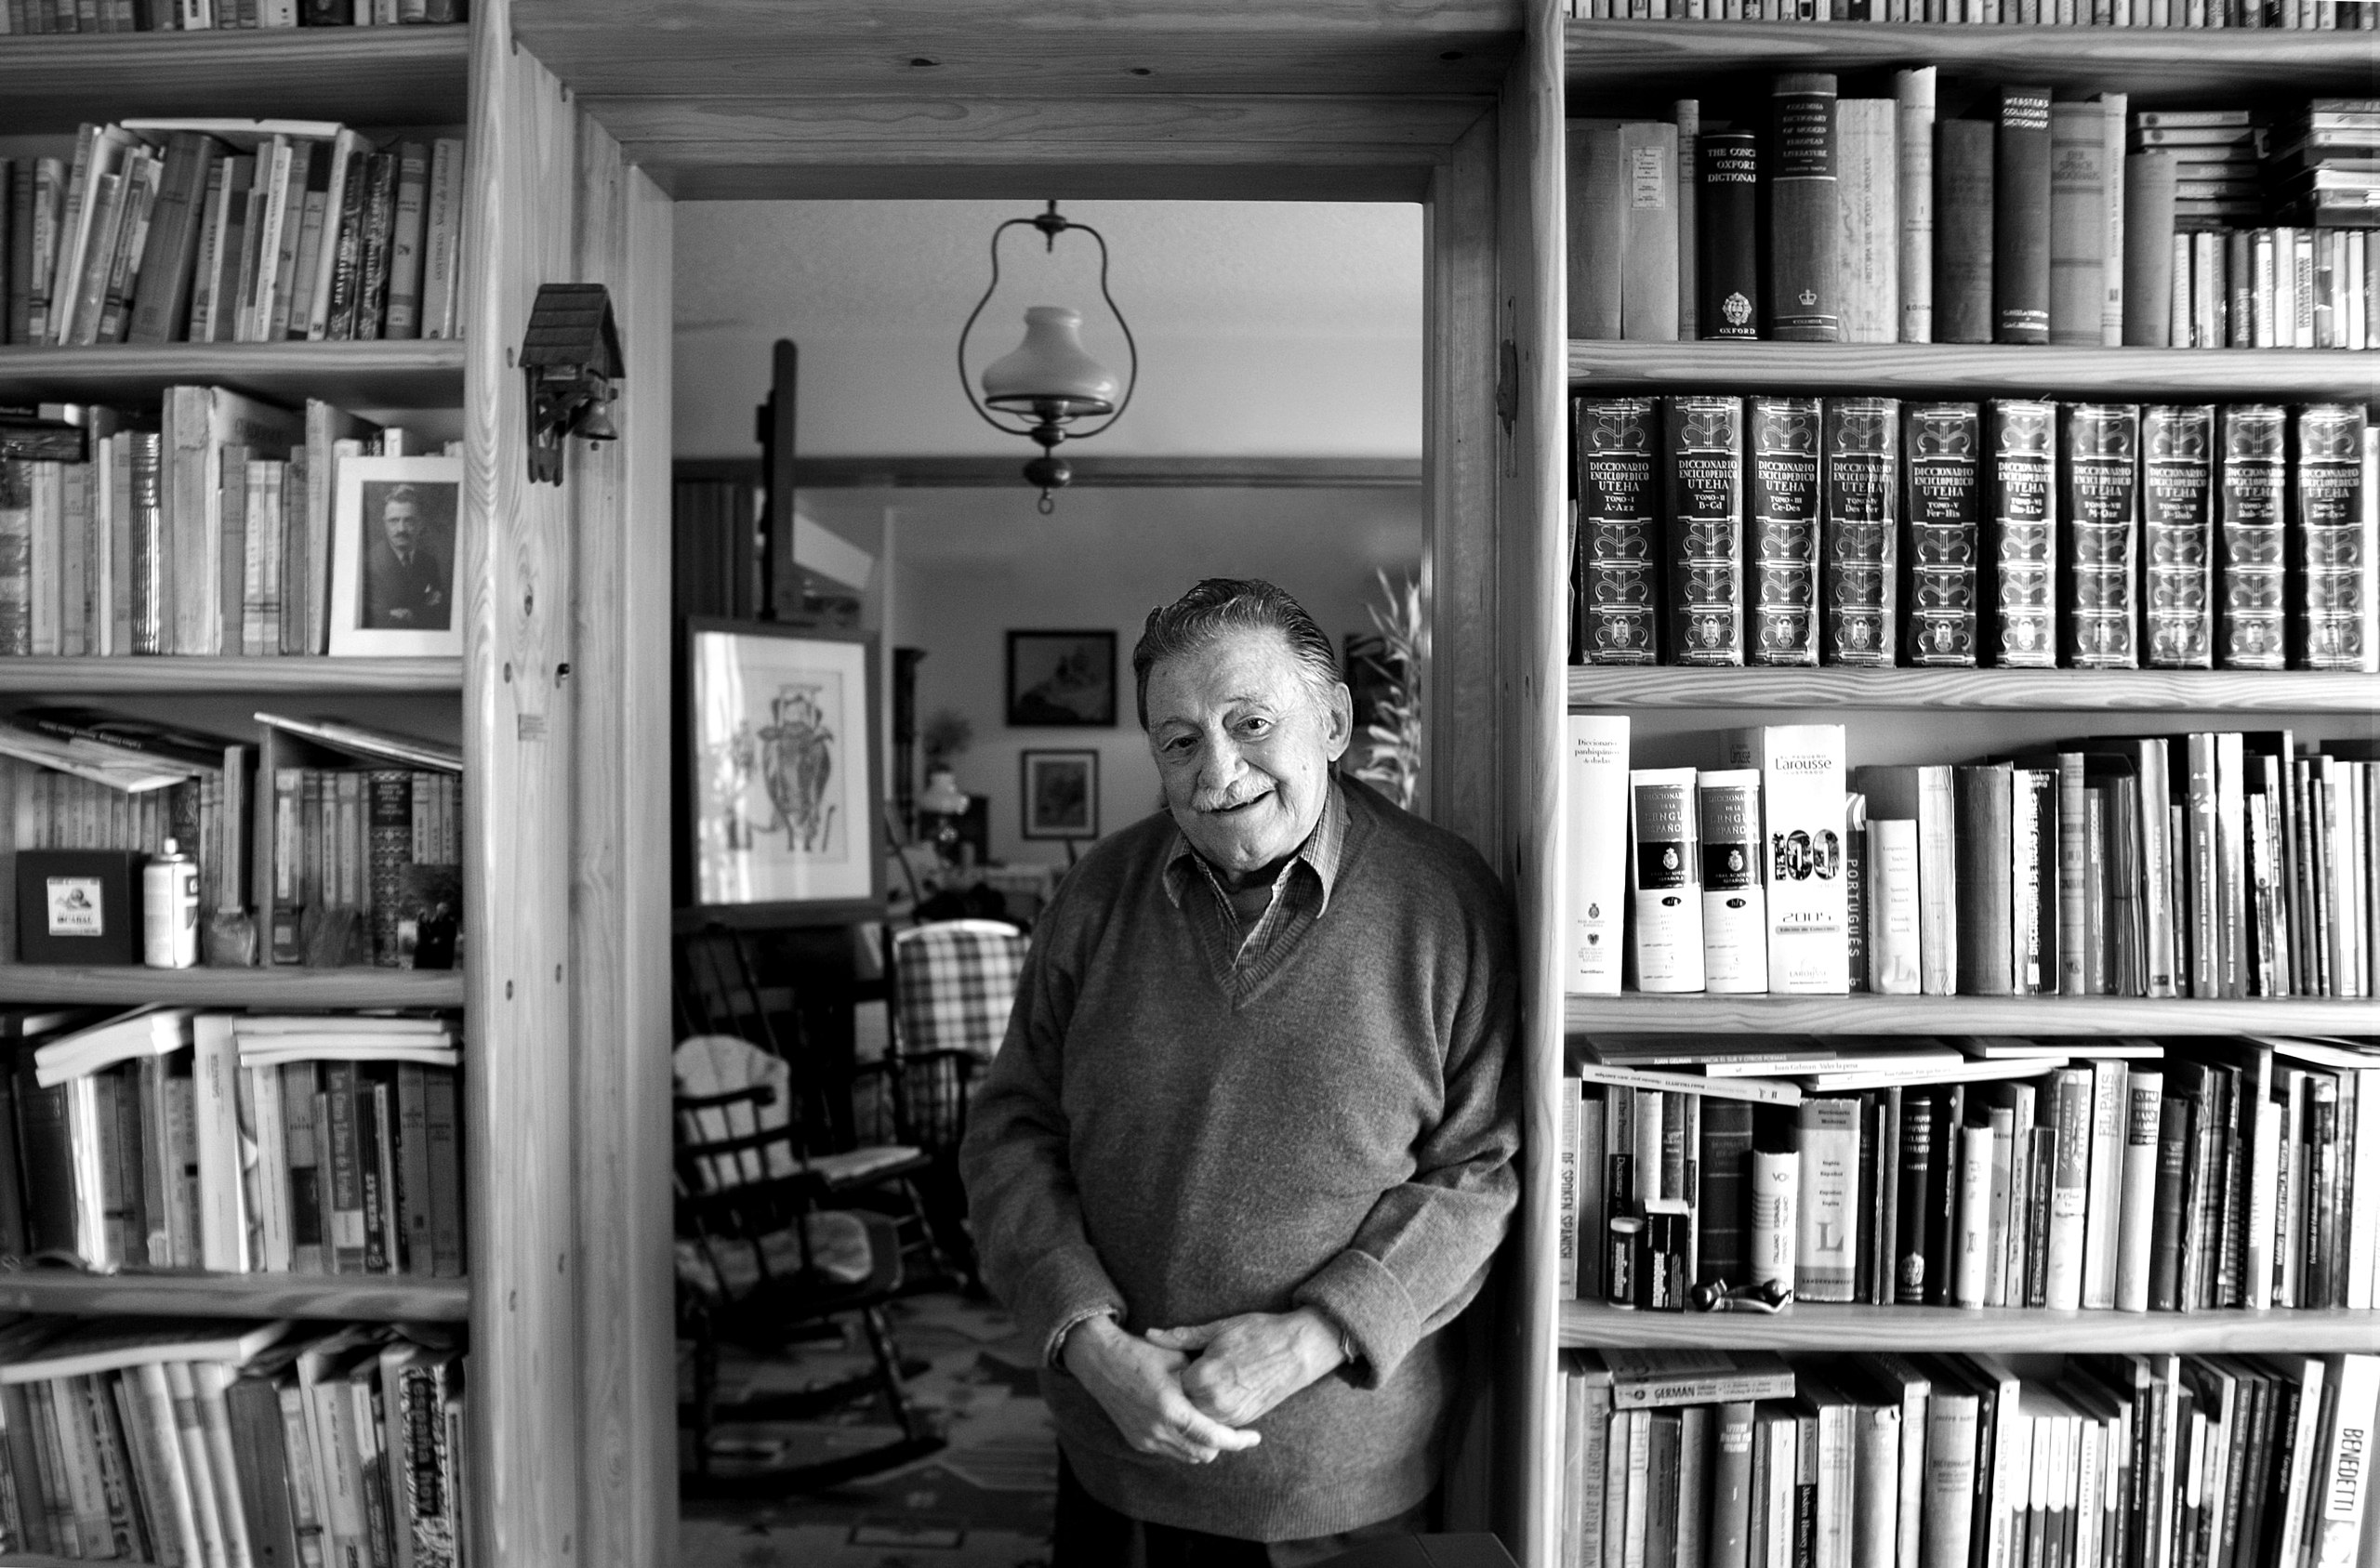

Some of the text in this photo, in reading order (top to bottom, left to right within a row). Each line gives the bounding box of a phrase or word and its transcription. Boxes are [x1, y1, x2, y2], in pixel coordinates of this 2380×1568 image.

[2003, 119, 2048, 129] DICTIONARY
[1708, 174, 1755, 182] DICTIONA
[1590, 462, 1648, 471] DICCIONARIO
[1679, 460, 1737, 469] DICCIONARIO
[1759, 461, 1815, 472] DICCIONARIO
[1834, 463, 1891, 473] DICCIONARIO
[1999, 462, 2054, 472] DICCIONARIO
[1679, 469, 1737, 479] ENCICLOPEDICO
[1759, 470, 1815, 481] ENCICLOPEDICO
[1914, 468, 1973, 476] DICCIONARIO
[2074, 466, 2131, 476] DICCIONARIO
[2149, 468, 2206, 477] DICCIONARIO
[2226, 468, 2285, 477] DICCIONARIO
[2302, 468, 2359, 478] DICCIONARIO
[1591, 472, 1649, 481] ENCICLOPEDICO
[1834, 473, 1892, 482] ENCICLOPEDICO
[1915, 477, 1974, 485] ENCICLOPEDICO
[1999, 472, 2054, 482] ENCICLOPEDICO
[2074, 476, 2131, 485] ENCICLOPEDICO
[2149, 477, 2206, 486] ENCICLOPEDICO
[1599, 481, 1639, 491] UTEHA
[1688, 480, 1728, 489] UTEHA
[1766, 481, 1805, 492] UTEHA
[1842, 482, 1883, 492] UTEHA
[2006, 481, 2044, 493] UTEHA
[2226, 478, 2285, 486] ENCICLOPEDICO
[2302, 478, 2359, 487] ENCICLOPEDICO
[1924, 486, 1964, 496] UTEHA
[2082, 485, 2122, 495] UTEHA
[2156, 487, 2197, 497] UTEHA
[2235, 487, 2278, 497] UTEHA
[2308, 488, 2349, 497] UTEHA
[1730, 746, 1751, 763] Larousse
[1776, 758, 1831, 770] Larousse
[1644, 792, 1681, 800] DICCIONA
[1645, 811, 1683, 821] LENGU
[1771, 829, 1840, 881] 100
[1847, 859, 1862, 957] PORTUGUÉS
[2098, 1115, 2111, 1137] EL
[1562, 1153, 1574, 1166] OF
[1615, 1157, 1625, 1198] Dictionary
[1561, 1170, 1573, 1210] SPOKEN
[1560, 1215, 1573, 1258] SPANISH
[1816, 1222, 1844, 1251] L
[1614, 1243, 1628, 1298] magnogene
[1653, 1252, 1666, 1308] magnogene
[1655, 1386, 1695, 1399] GERMAN
[2240, 1388, 2249, 1409] Mario
[2257, 1390, 2266, 1410] Mario
[2289, 1393, 2299, 1414] Mario
[2235, 1410, 2247, 1443] Benedetti
[2254, 1411, 2264, 1443] Benedetti
[2284, 1416, 2297, 1448] Benedetti
[411, 1381, 434, 1512] españa hoy
[2333, 1428, 2364, 1511] BENEDETTI
[1583, 1403, 1603, 1568] NUAL BREVE DE LENGUA RUSA
